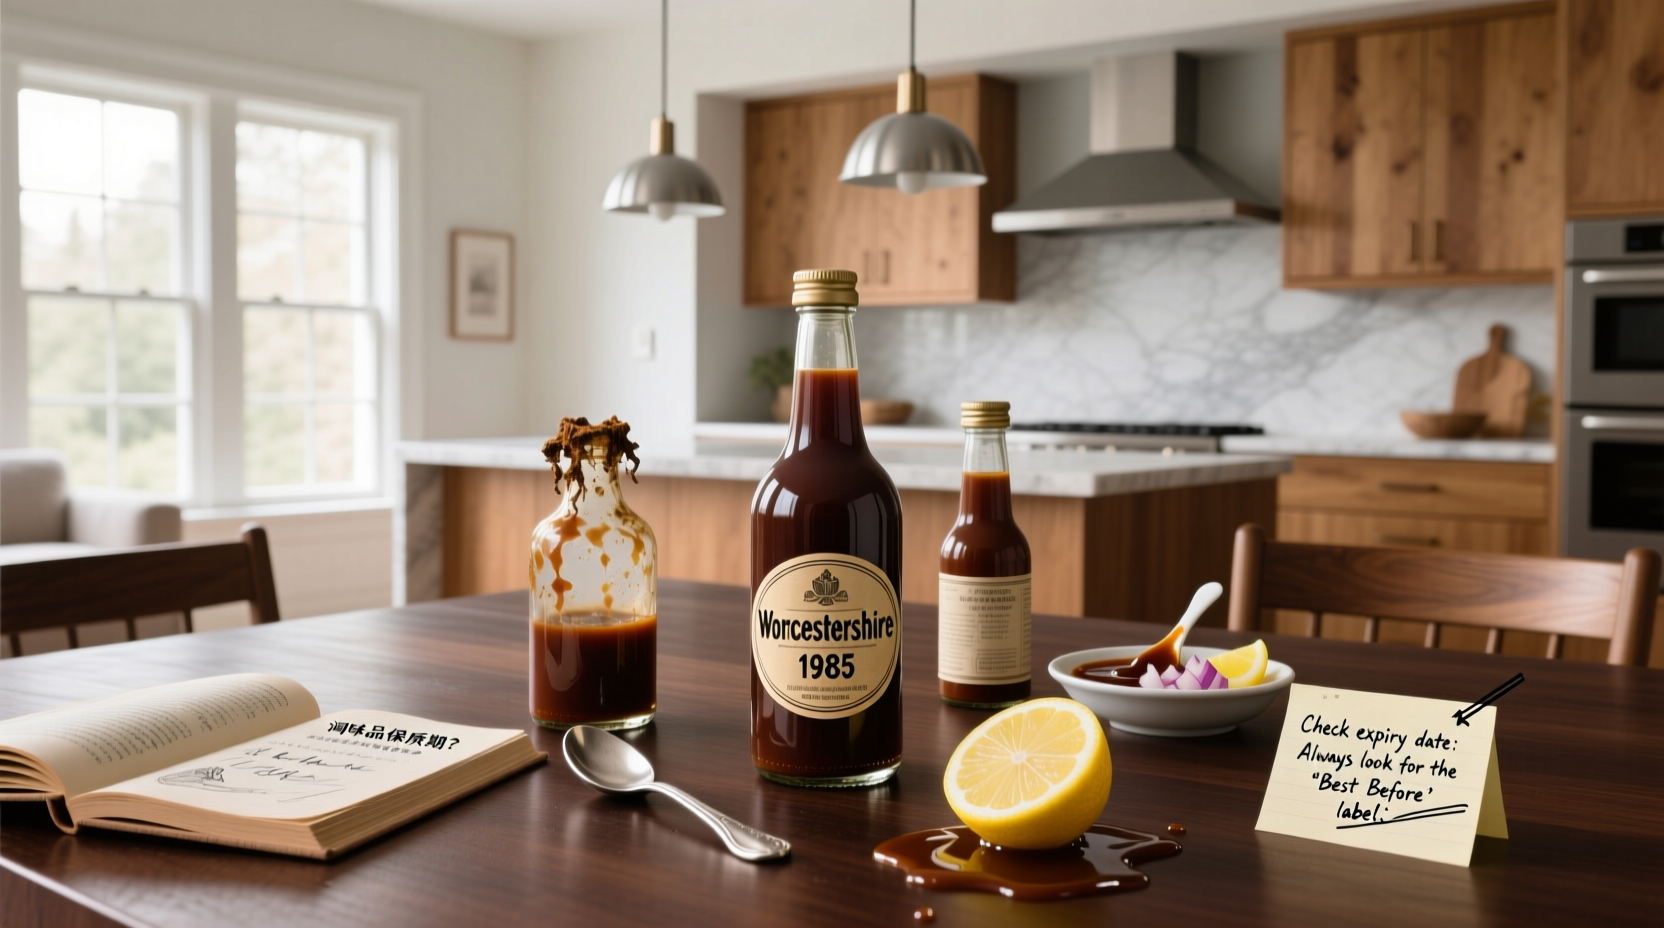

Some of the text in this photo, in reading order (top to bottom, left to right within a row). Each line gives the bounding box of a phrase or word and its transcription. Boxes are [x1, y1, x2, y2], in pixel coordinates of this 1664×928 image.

[758, 609, 894, 642] Worcestershire
[798, 653, 855, 680] 1985
[1300, 714, 1458, 753] Check expiry date:
[1297, 742, 1457, 779] Always look for the
